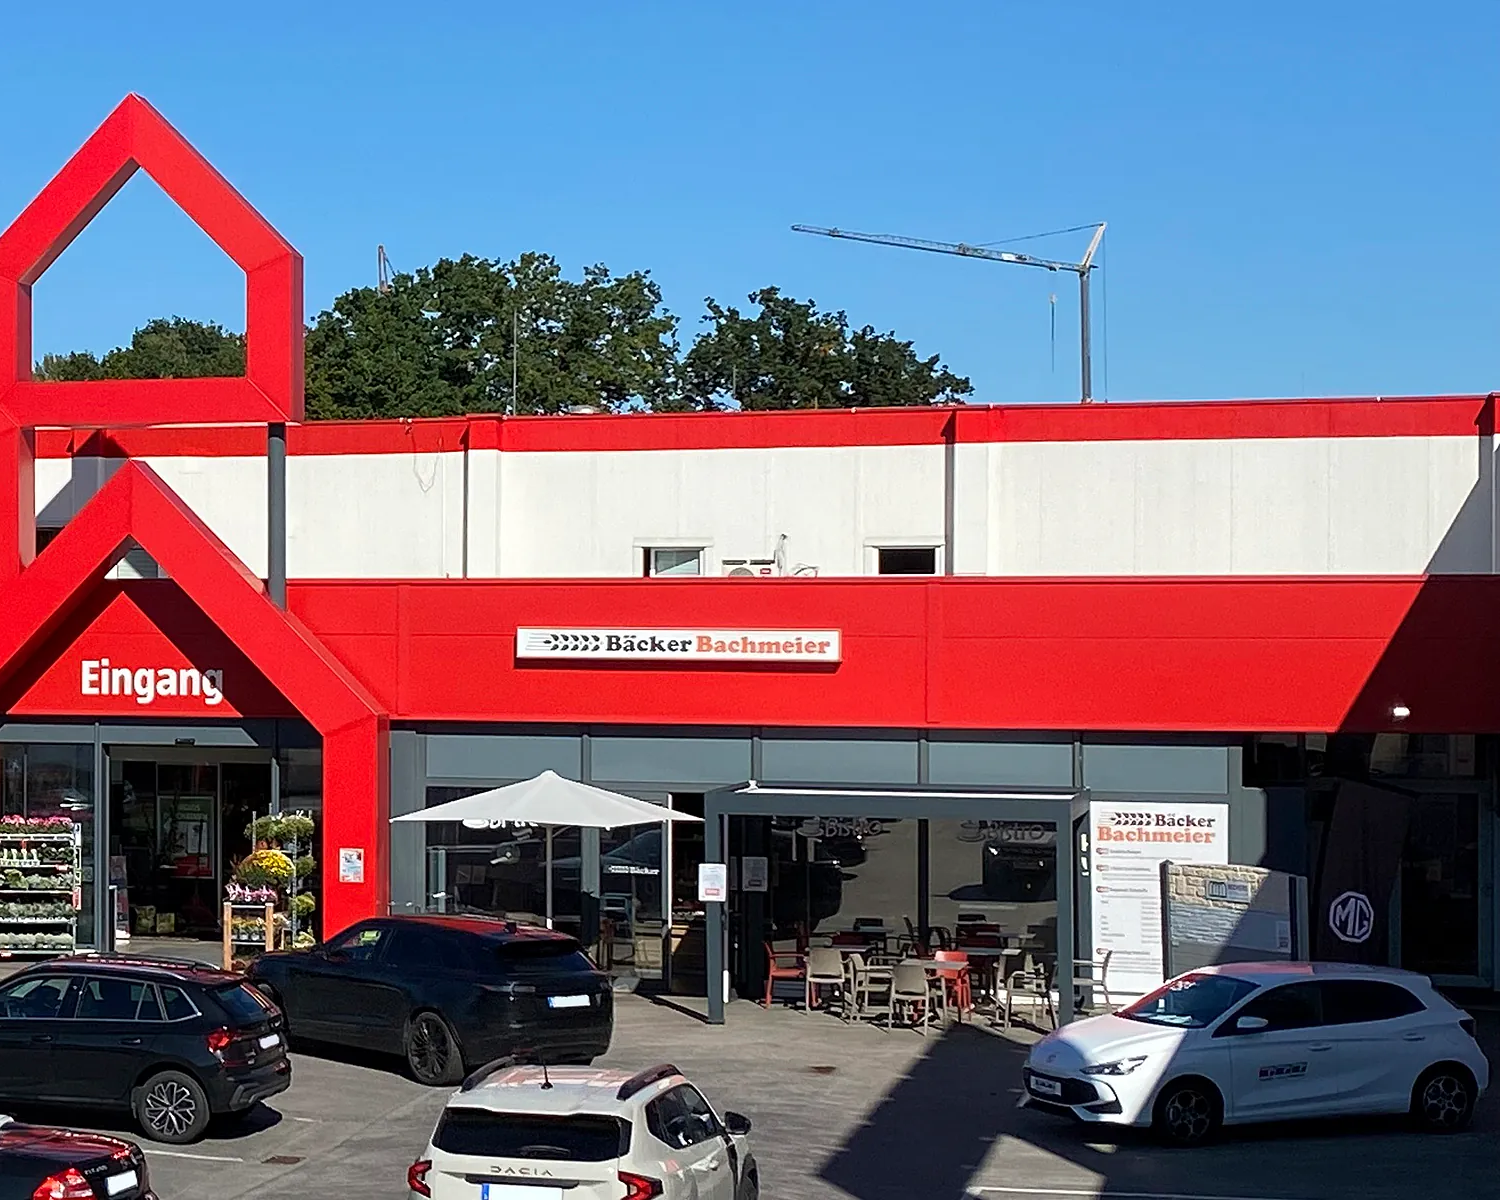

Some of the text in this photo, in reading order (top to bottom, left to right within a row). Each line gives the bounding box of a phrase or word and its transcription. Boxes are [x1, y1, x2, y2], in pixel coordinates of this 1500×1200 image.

[606, 635, 830, 654] Bäcker Bachmeier
[81, 658, 223, 705] Eingang
[1154, 813, 1216, 827] Bäcker
[987, 820, 1044, 841] Bistro
[1097, 826, 1216, 843] Bachmeier
[1335, 898, 1369, 936] MG
[490, 1165, 553, 1177] DACIA
